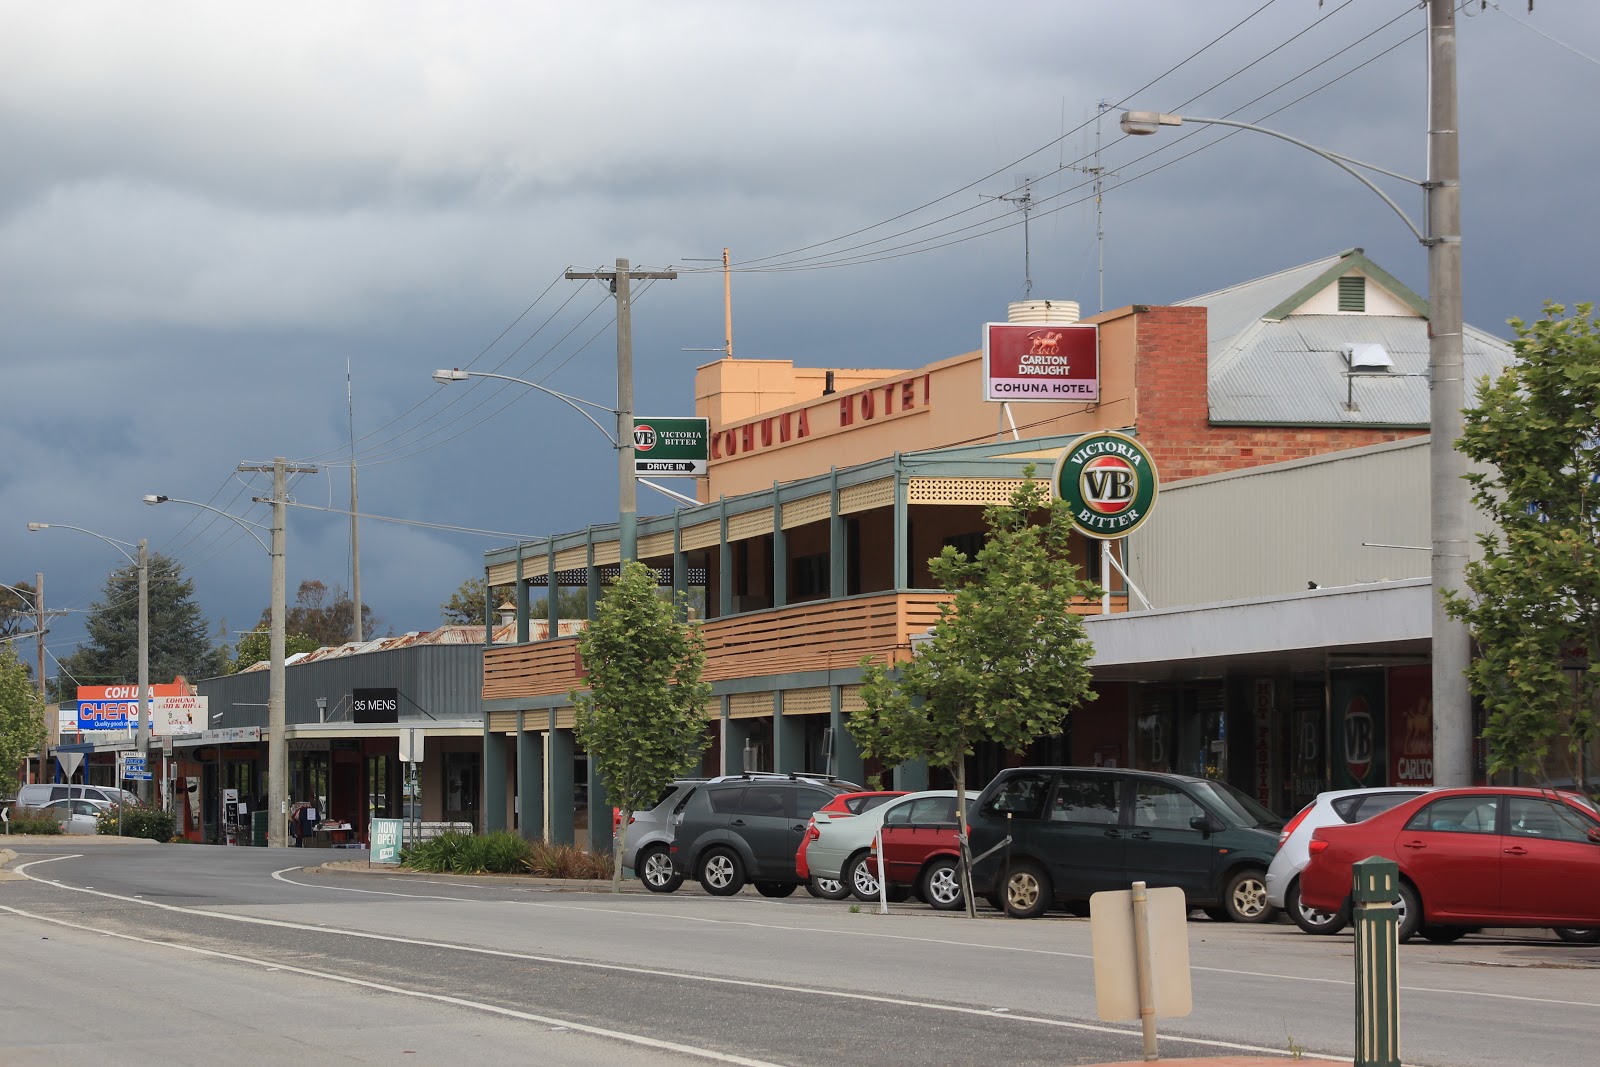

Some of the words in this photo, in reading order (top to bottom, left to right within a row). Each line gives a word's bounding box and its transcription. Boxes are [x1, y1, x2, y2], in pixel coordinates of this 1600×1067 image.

[1020, 355, 1067, 365] CARLTON
[1018, 365, 1070, 375] DRAUGHT
[995, 383, 1048, 393] COHUNA
[1053, 384, 1094, 393] HOTEL
[634, 431, 655, 445] VB
[660, 431, 702, 439] VICTORIA
[711, 407, 809, 460] COHUNA
[1070, 441, 1142, 467] VICTORIA
[647, 463, 674, 471] DRIVE
[676, 463, 686, 471] IN
[1083, 470, 1134, 500] VB
[1078, 508, 1140, 528] BITTER
[105, 687, 154, 699] COHUA
[354, 700, 366, 711] 35
[368, 699, 397, 711] MENS
[1257, 683, 1270, 719] HOT
[95, 720, 110, 728] Quality
[1345, 716, 1372, 762] VB
[1398, 757, 1433, 780] CARLTO
[378, 821, 397, 834] NOW
[377, 833, 396, 846] OPEN
